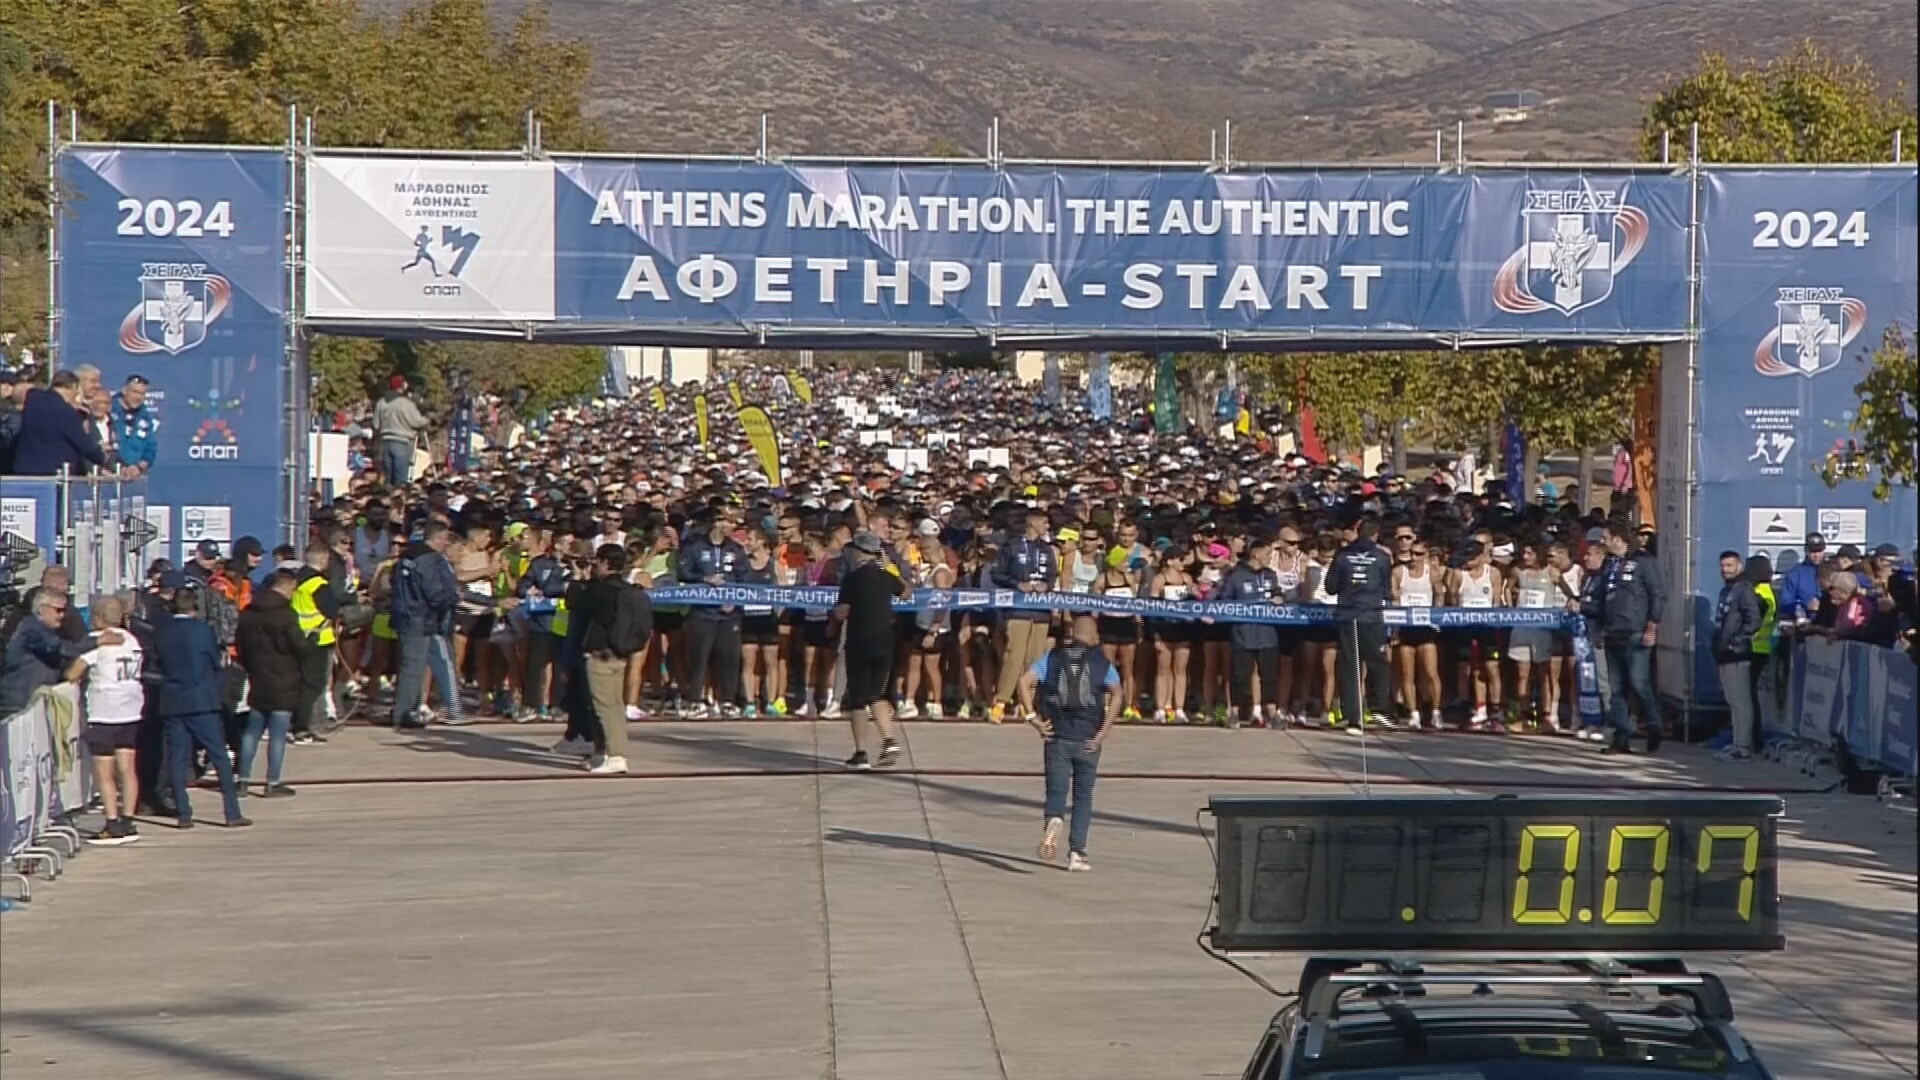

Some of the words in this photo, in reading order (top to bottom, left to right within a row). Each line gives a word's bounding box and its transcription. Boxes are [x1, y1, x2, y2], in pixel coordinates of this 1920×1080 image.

[394, 182, 489, 195] ΜΑΡΑΘΩΝΙΟΣ
[412, 196, 472, 208] ΑΘΗΝΑΣ
[1526, 189, 1616, 211] ΣΕΓΑΣ
[117, 198, 235, 238] 2024
[591, 190, 767, 229] ATHENS
[786, 192, 1056, 235] MARATHON.
[1067, 199, 1151, 236] THE
[1160, 200, 1410, 238] AUTHENTIC
[1752, 210, 1870, 249] 2024
[141, 262, 208, 278] ΣΕΓΑΣ
[1778, 286, 1844, 301] ΣΕΓΑΣ
[766, 588, 792, 602] THE
[1207, 601, 1295, 619] ΑΥΘΕΝΤΙΚΟΣ
